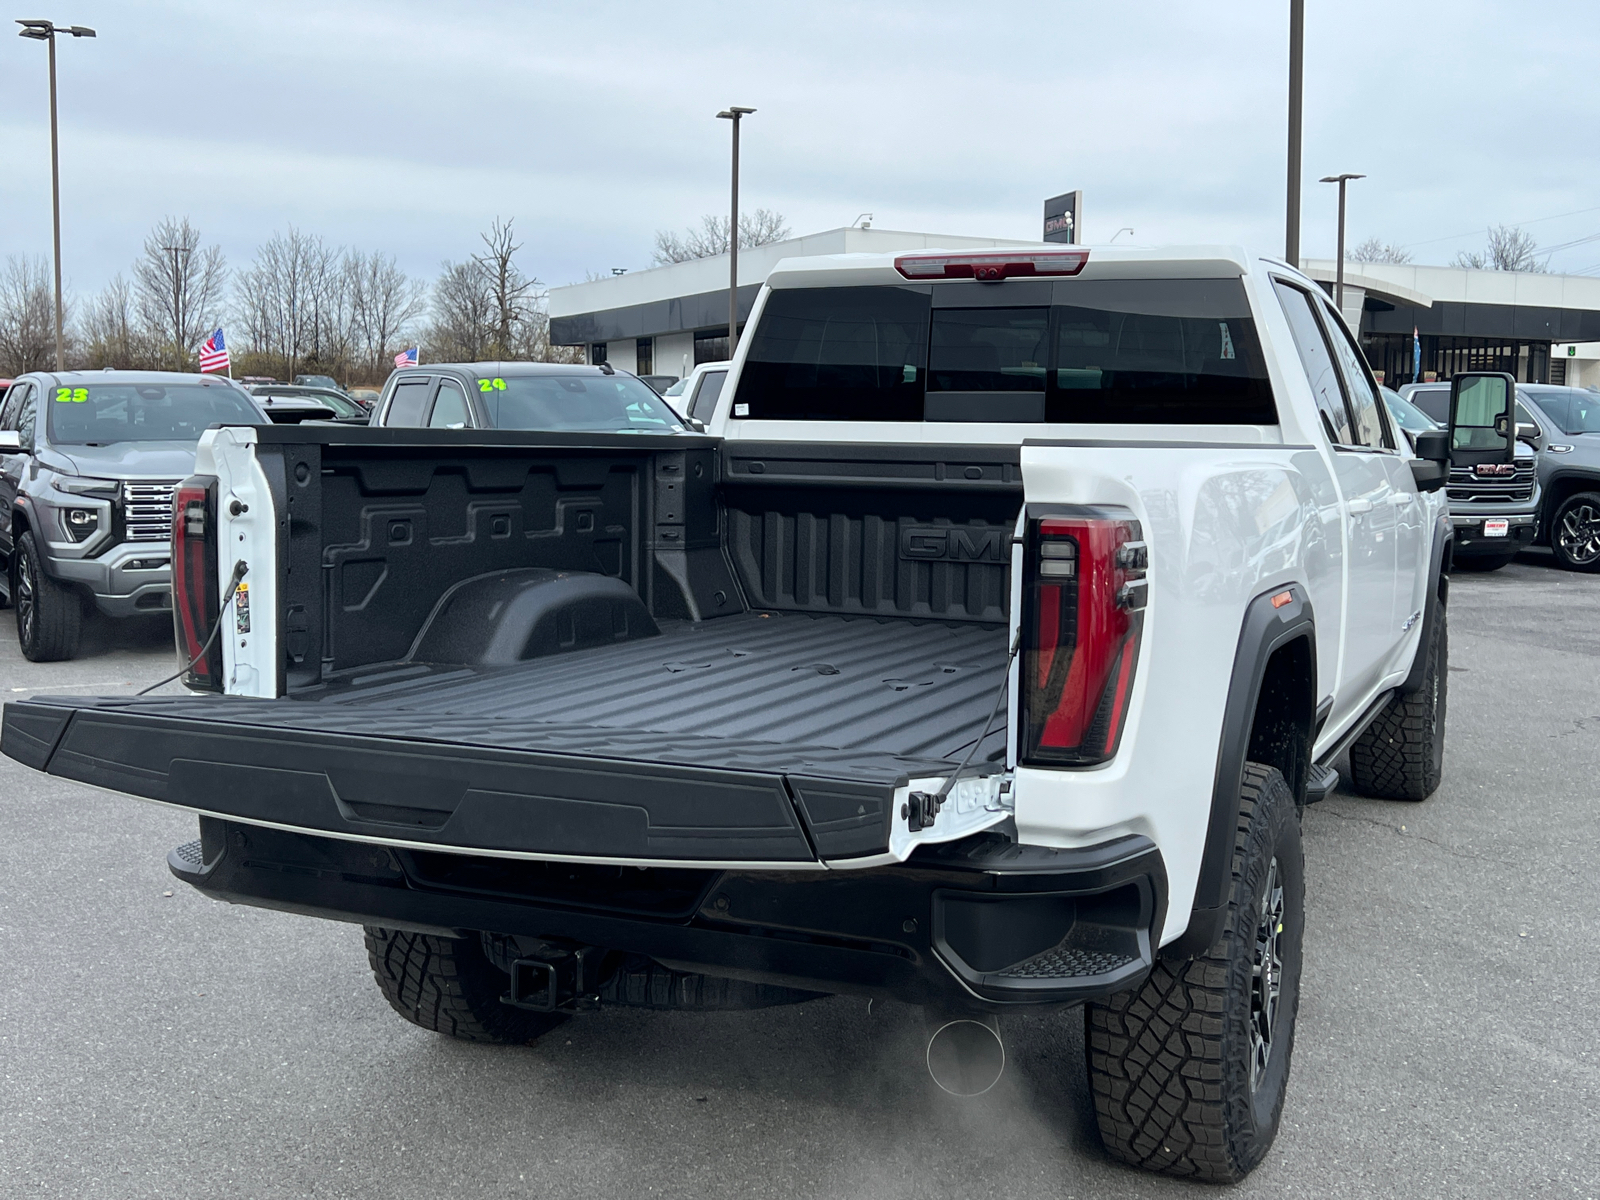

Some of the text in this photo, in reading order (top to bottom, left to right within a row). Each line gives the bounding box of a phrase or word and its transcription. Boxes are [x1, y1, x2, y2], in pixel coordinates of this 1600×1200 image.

[55, 387, 89, 403] 23
[1476, 463, 1515, 475] GMC
[901, 528, 1012, 561] GM
